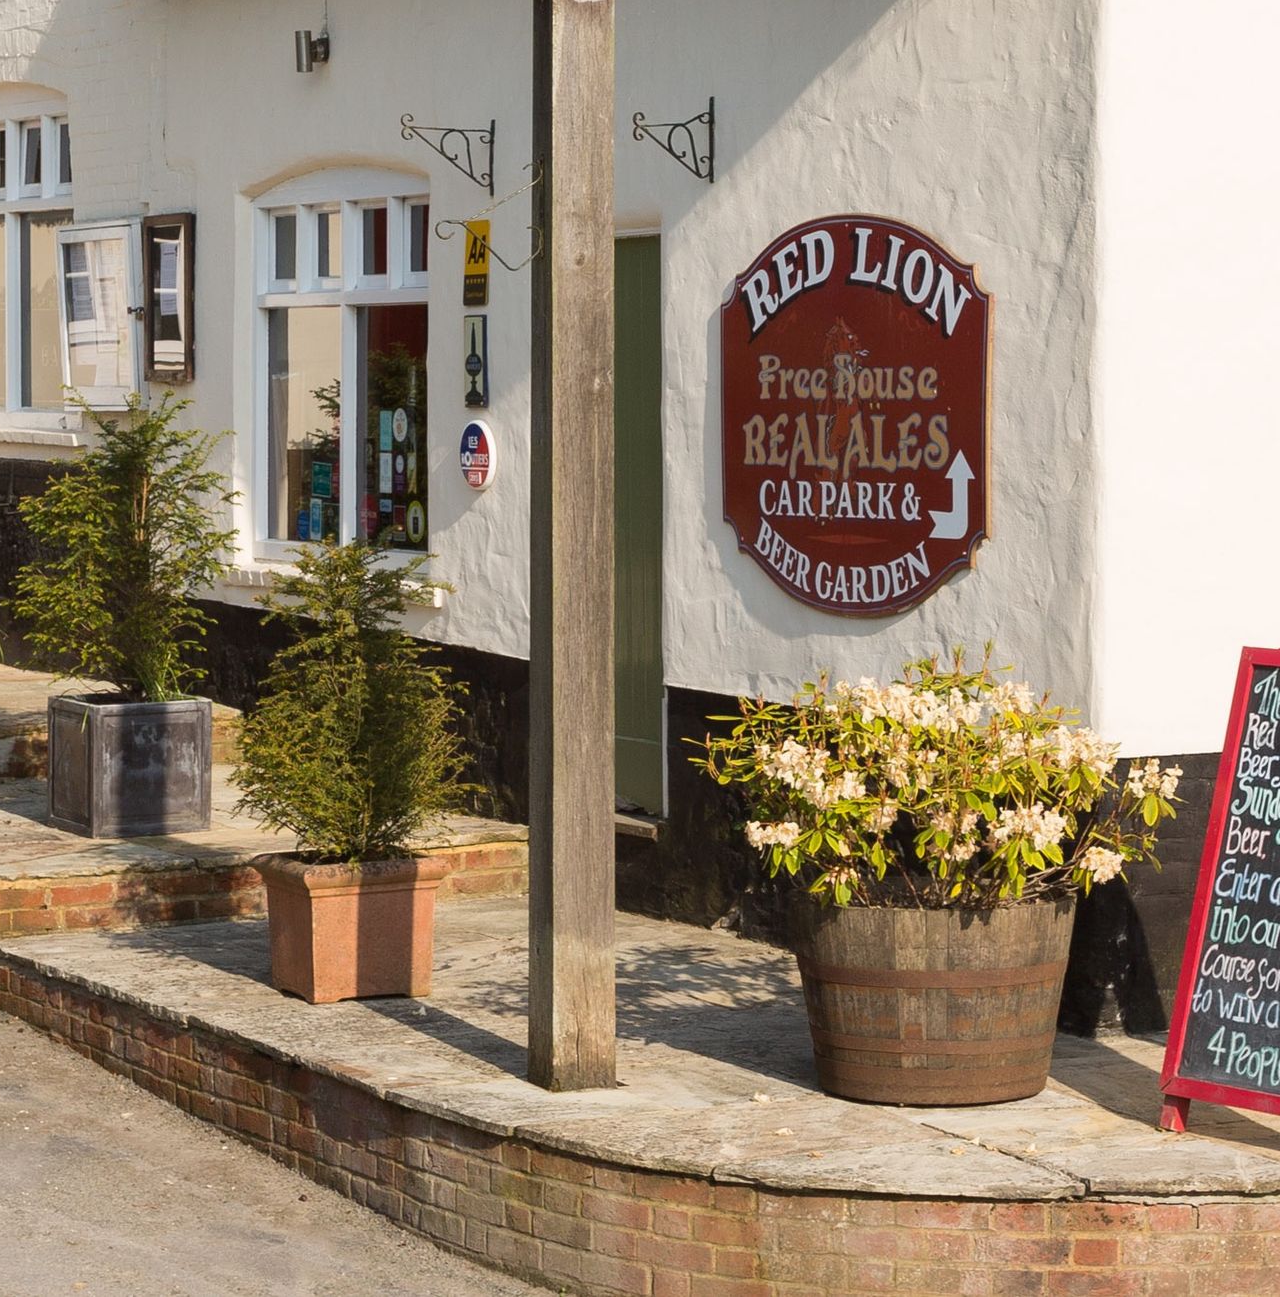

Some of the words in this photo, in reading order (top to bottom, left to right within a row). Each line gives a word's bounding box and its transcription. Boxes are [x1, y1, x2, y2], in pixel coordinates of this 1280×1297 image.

[467, 234, 486, 264] AA
[741, 230, 835, 334] RED
[850, 227, 972, 337] LION
[758, 354, 828, 400] Free
[742, 412, 839, 480] REAL
[842, 411, 950, 480] ALES
[759, 479, 815, 517] CAR
[819, 481, 897, 520] PARK
[901, 482, 922, 522] &
[754, 516, 811, 593] BEER
[815, 540, 931, 603] GARDEN
[1243, 713, 1279, 751] Red
[1237, 747, 1280, 780] Beer
[1215, 858, 1271, 903] Enter
[1210, 899, 1251, 944] into
[1201, 944, 1256, 982] Course
[1192, 978, 1213, 1013] to
[1218, 988, 1265, 1025] WIN
[1265, 1000, 1280, 1029] a
[1207, 1026, 1226, 1066] 4
